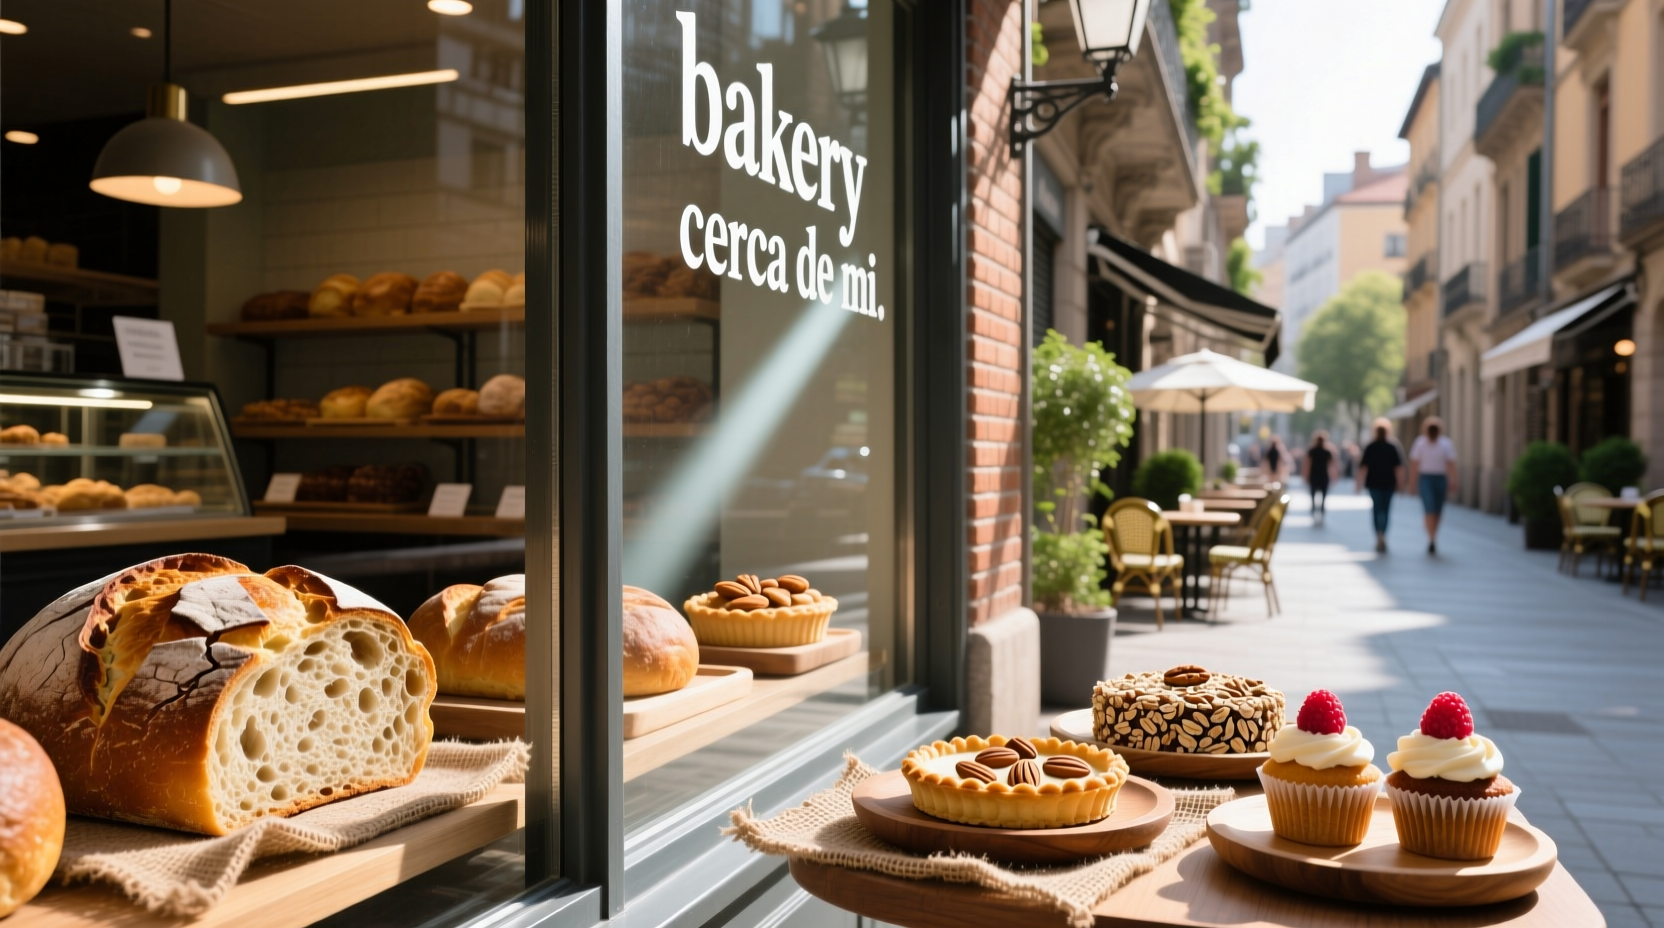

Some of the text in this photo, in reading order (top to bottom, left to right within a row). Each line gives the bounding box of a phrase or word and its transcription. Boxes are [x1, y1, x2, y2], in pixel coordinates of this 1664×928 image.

[676, 11, 867, 247] bakery
[680, 204, 885, 321] cerca de mi.
